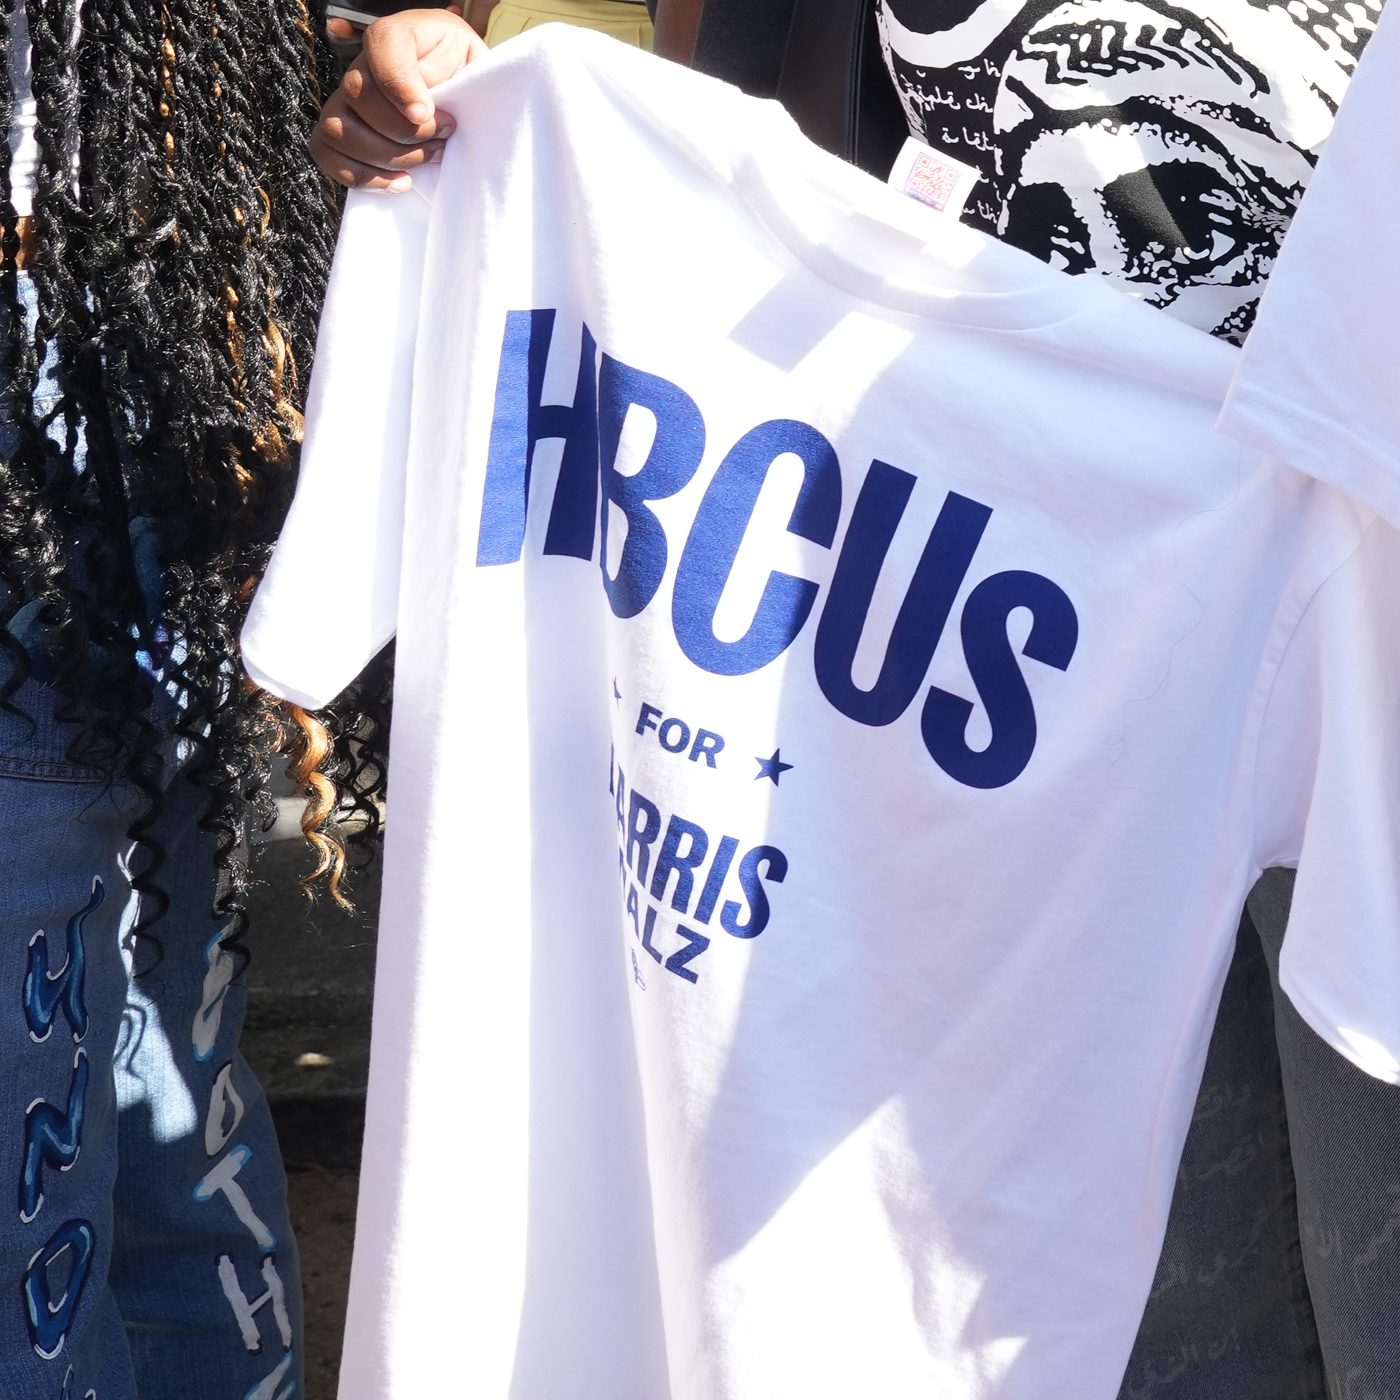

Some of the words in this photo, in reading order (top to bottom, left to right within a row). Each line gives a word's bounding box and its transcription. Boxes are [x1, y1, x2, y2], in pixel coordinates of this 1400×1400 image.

[477, 308, 1079, 789] HBCUs
[636, 701, 725, 769] FOR
[609, 743, 788, 939] ARRIS
[618, 846, 711, 985] ALZ
